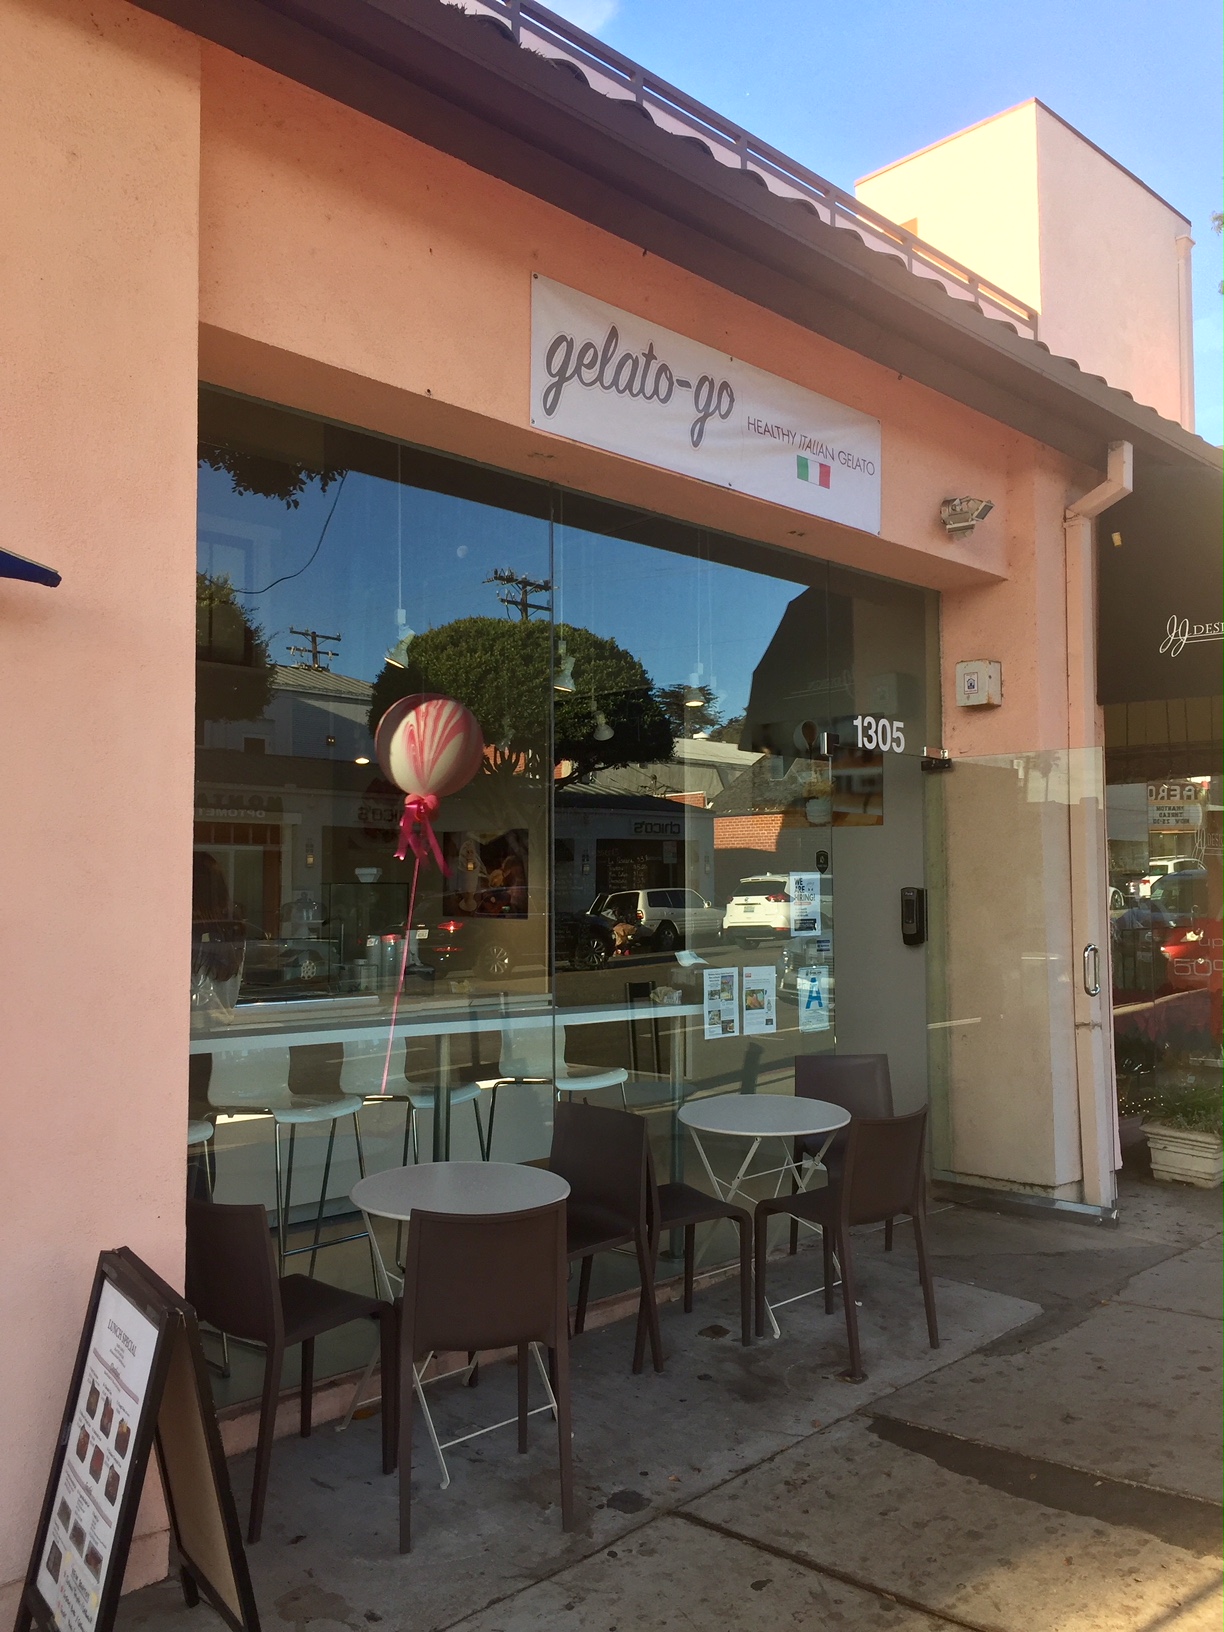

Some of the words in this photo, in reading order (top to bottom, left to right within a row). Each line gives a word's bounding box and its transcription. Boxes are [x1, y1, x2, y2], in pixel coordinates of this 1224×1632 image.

[543, 325, 735, 448] gelato-go
[747, 416, 797, 449] HEALTHY
[798, 434, 835, 462] ITALIAN
[838, 451, 876, 476] GELATO
[853, 715, 905, 753] 1305
[794, 877, 803, 886] WE
[794, 885, 806, 893] ARE
[794, 893, 816, 902] HIRING!
[805, 976, 824, 1009] A
[107, 1318, 123, 1341] LUNCH
[121, 1332, 138, 1357] SPECIAL
